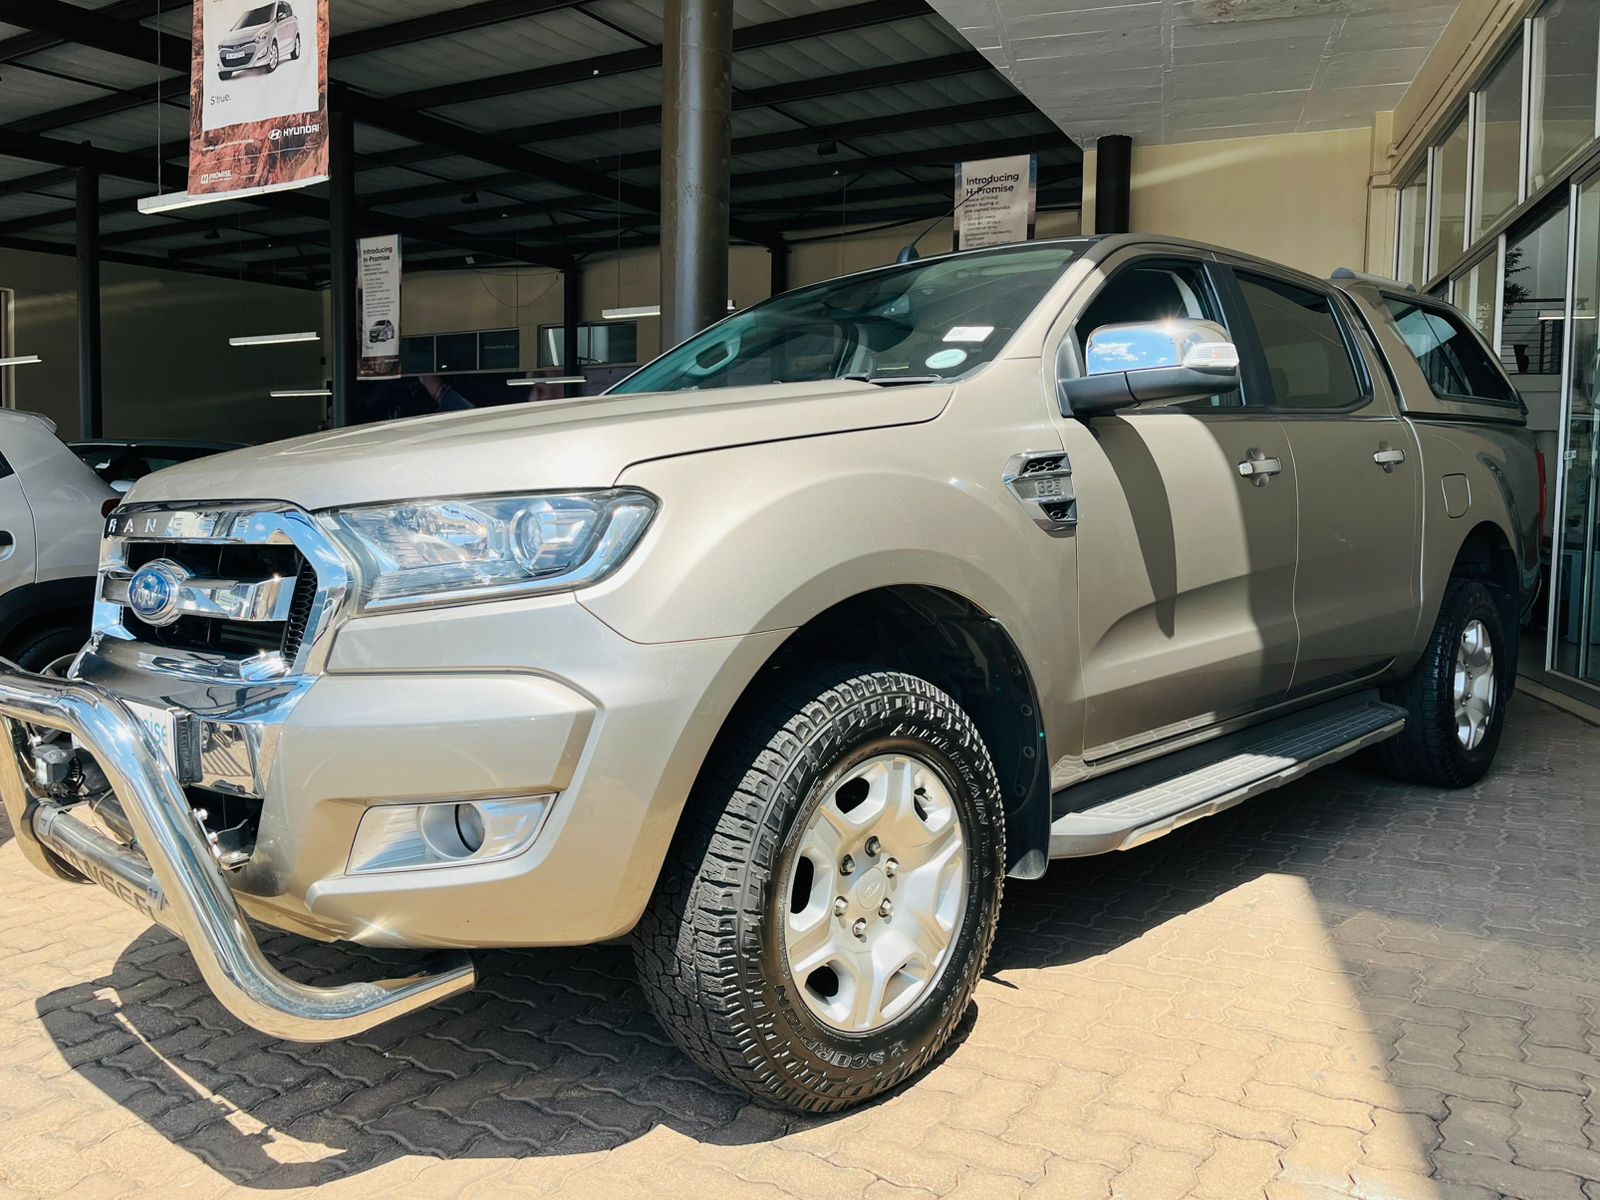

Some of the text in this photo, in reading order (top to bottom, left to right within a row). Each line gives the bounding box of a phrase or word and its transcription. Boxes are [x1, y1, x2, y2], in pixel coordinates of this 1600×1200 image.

[283, 124, 320, 137] HYUNDAI
[966, 173, 1019, 185] Introducing
[363, 246, 393, 255] Introducing
[363, 255, 390, 263] H-Promise
[107, 516, 249, 534] RANGER
[774, 986, 885, 1070] SCORPION
